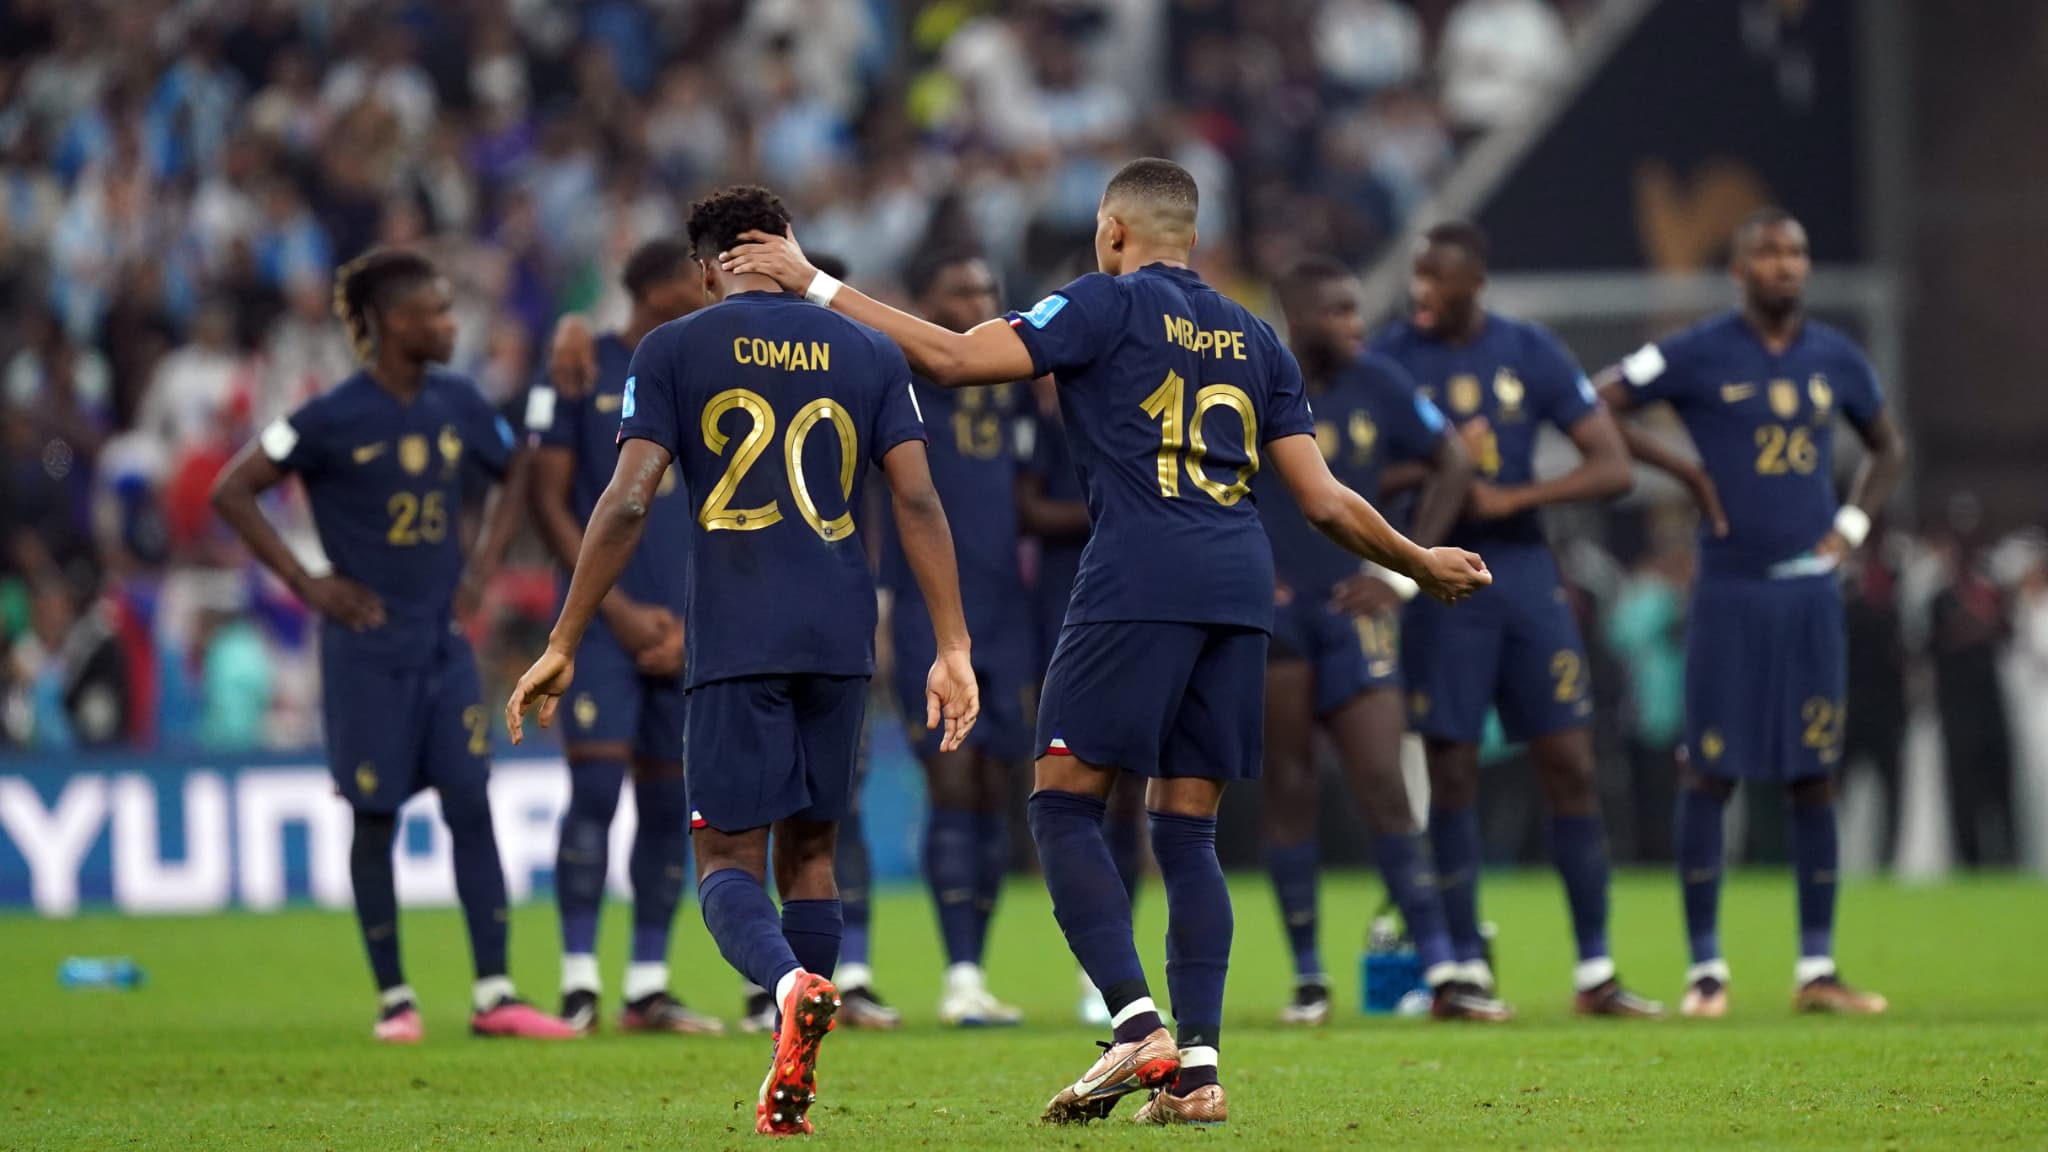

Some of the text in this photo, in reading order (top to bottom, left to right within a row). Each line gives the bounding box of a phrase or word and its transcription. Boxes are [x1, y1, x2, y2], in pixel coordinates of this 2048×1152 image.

[733, 336, 830, 371] COMAN
[1139, 368, 1260, 507] 10
[1754, 424, 1818, 475] 26
[699, 388, 858, 542] 20
[1549, 649, 1590, 703] 2
